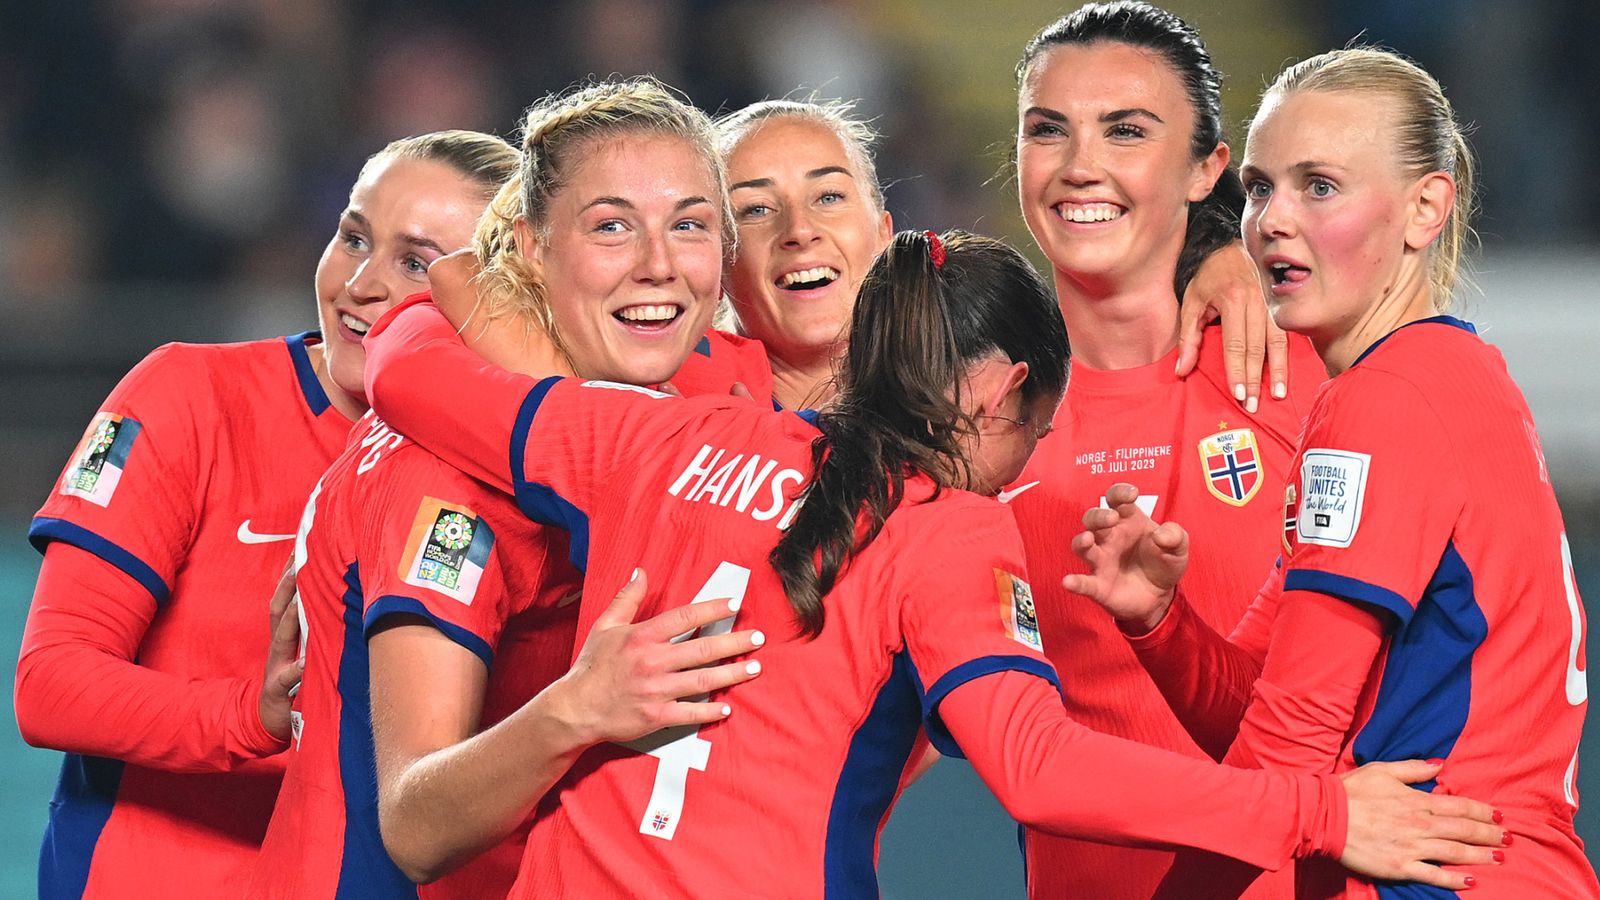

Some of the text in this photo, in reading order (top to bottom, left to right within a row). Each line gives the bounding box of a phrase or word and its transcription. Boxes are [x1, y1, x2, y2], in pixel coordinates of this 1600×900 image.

[1217, 433, 1235, 443] NORGE
[1076, 451, 1106, 465] NORGE
[1116, 445, 1172, 460] FILIPPINENE
[1090, 459, 1155, 474] 30. JULI 2023
[1311, 465, 1347, 480] FOOTBALL
[1309, 478, 1346, 497] UNITES
[1305, 495, 1347, 514] the World
[420, 568, 436, 579] NZ
